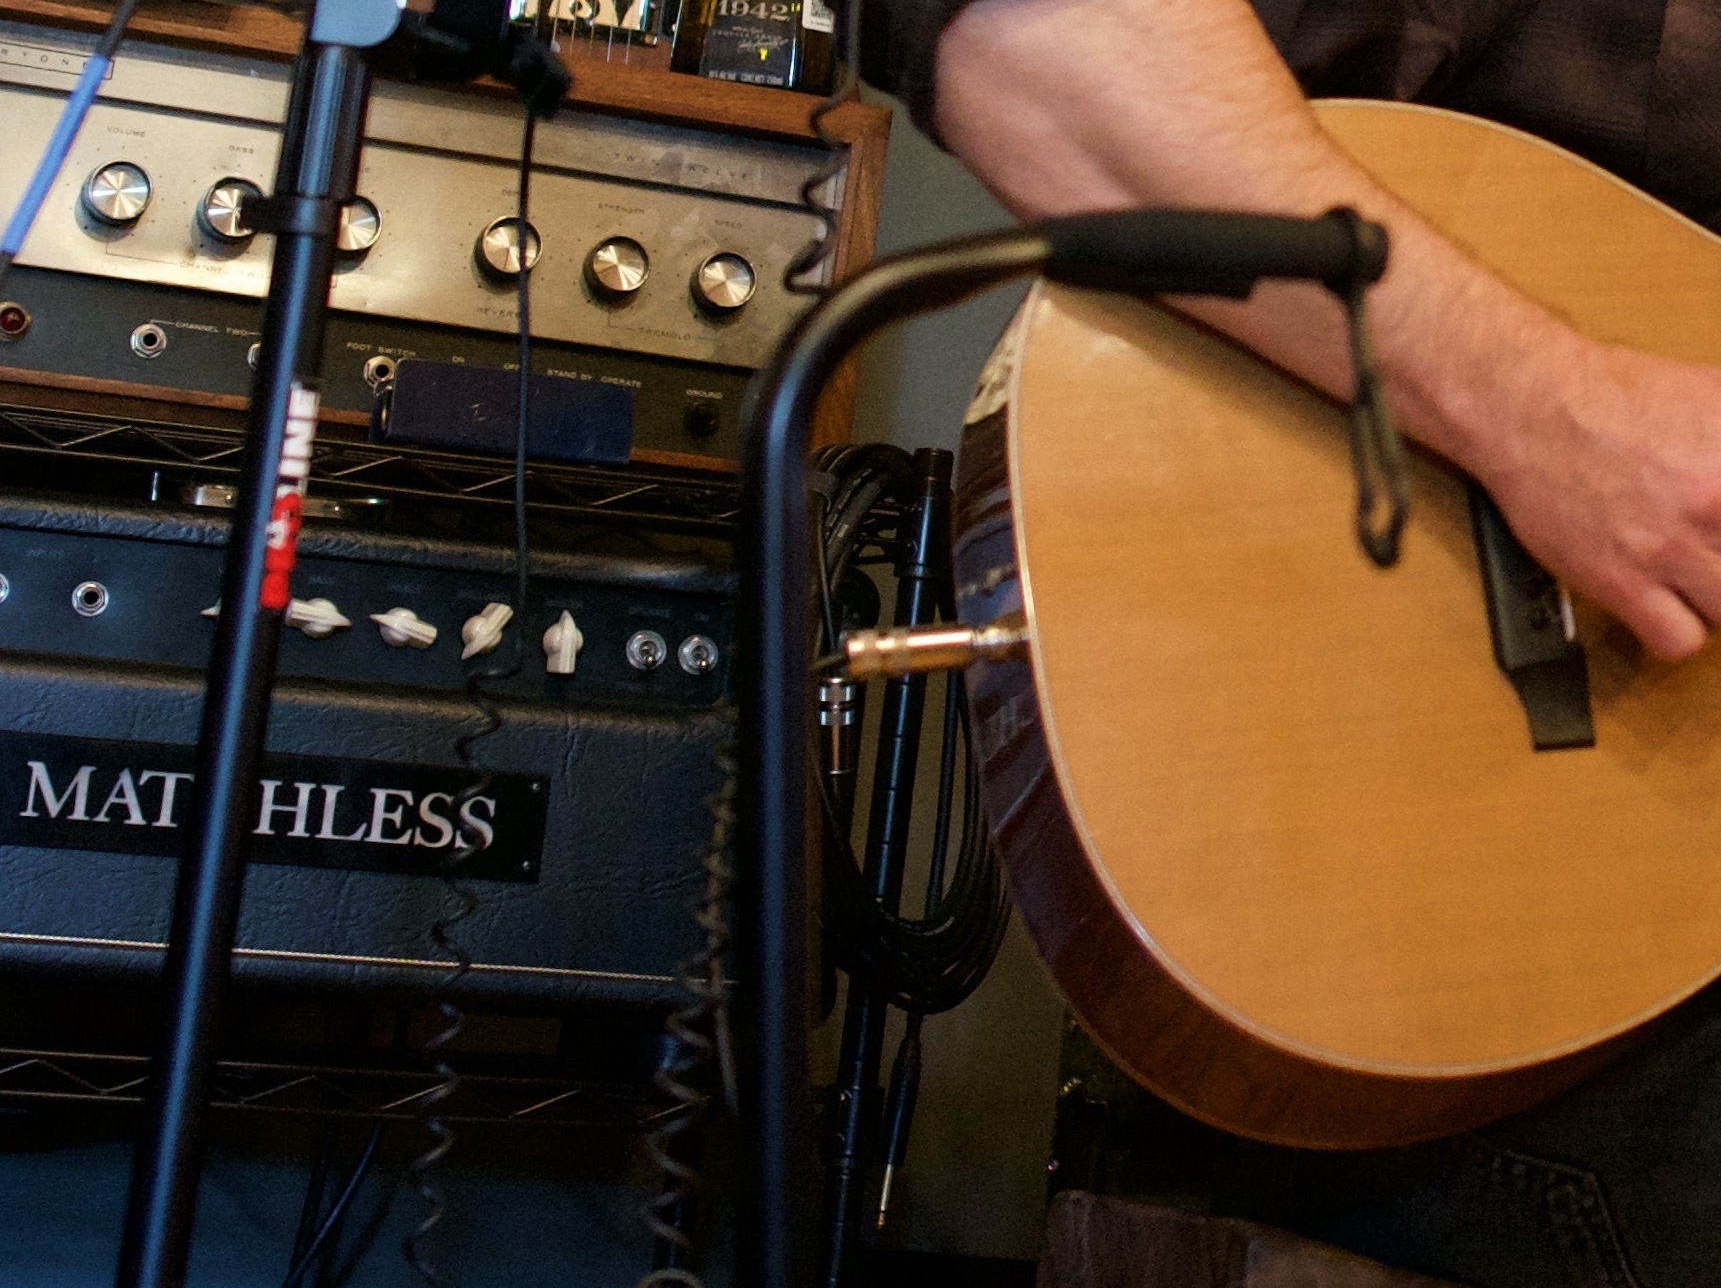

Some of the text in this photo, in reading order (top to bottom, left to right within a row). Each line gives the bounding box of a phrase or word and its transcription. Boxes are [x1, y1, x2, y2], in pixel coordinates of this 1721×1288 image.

[107, 125, 146, 138] VOLUME
[175, 321, 247, 337] CHANNEL TWO
[347, 343, 373, 352] FOOT
[451, 355, 466, 364] ON
[546, 368, 593, 382] STAND BY
[601, 376, 643, 389] OPERATE
[19, 761, 497, 852] MATHLESS
